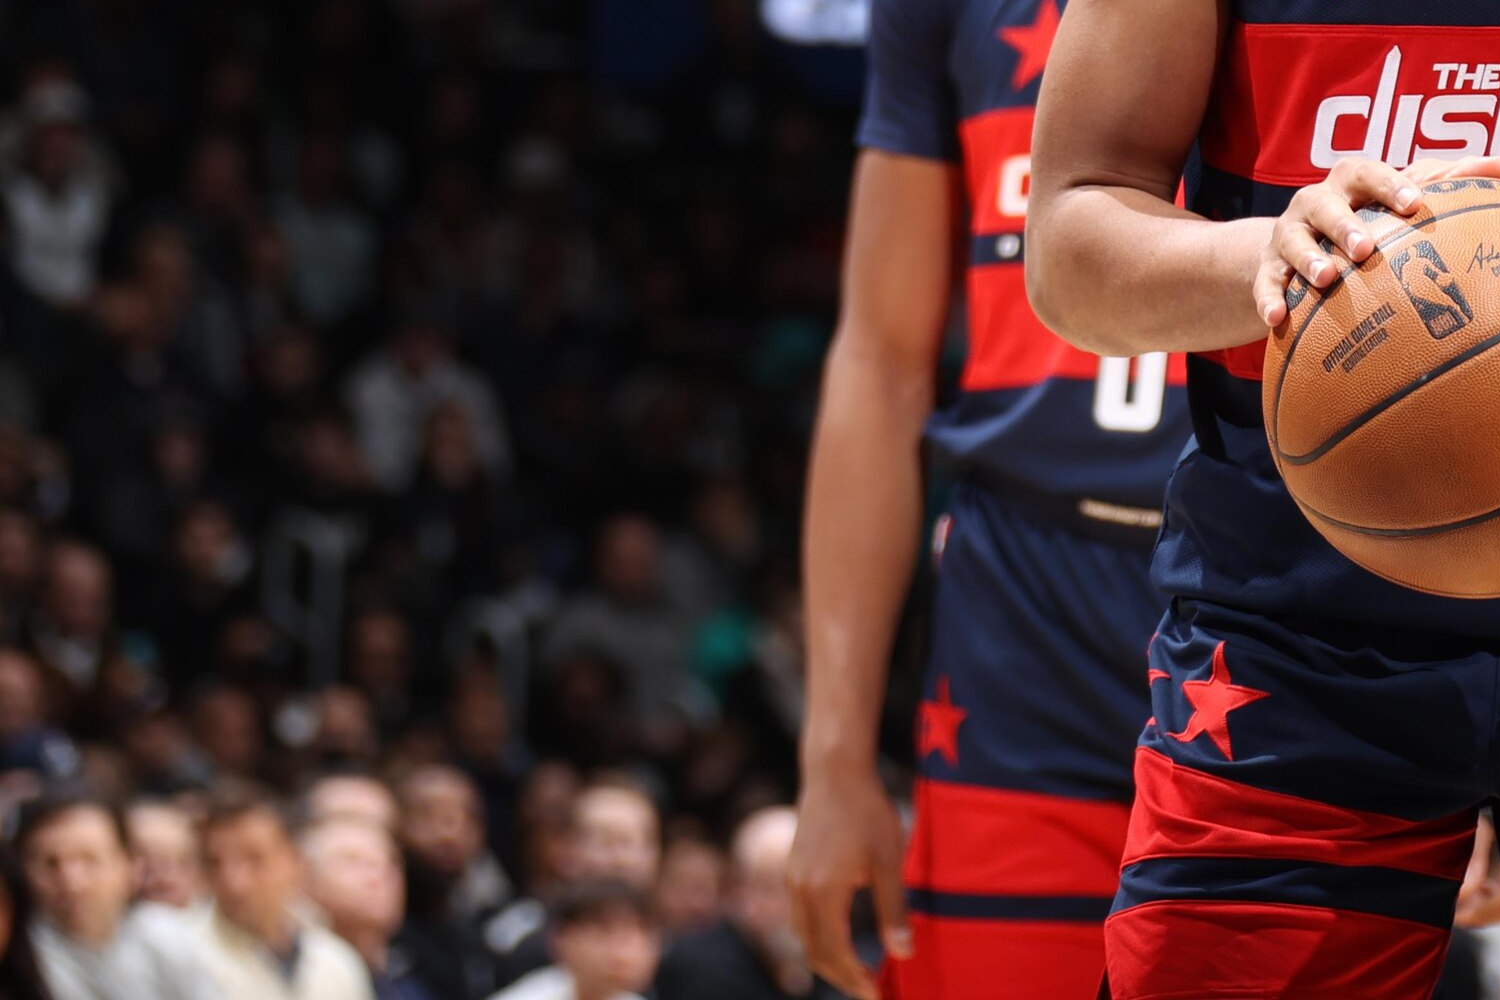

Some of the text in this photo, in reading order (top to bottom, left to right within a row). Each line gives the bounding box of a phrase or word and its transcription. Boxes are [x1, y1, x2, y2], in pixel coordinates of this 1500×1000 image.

[1322, 302, 1397, 373] OFFICIAL GAME BALL
[1363, 327, 1389, 353] LEATHER
